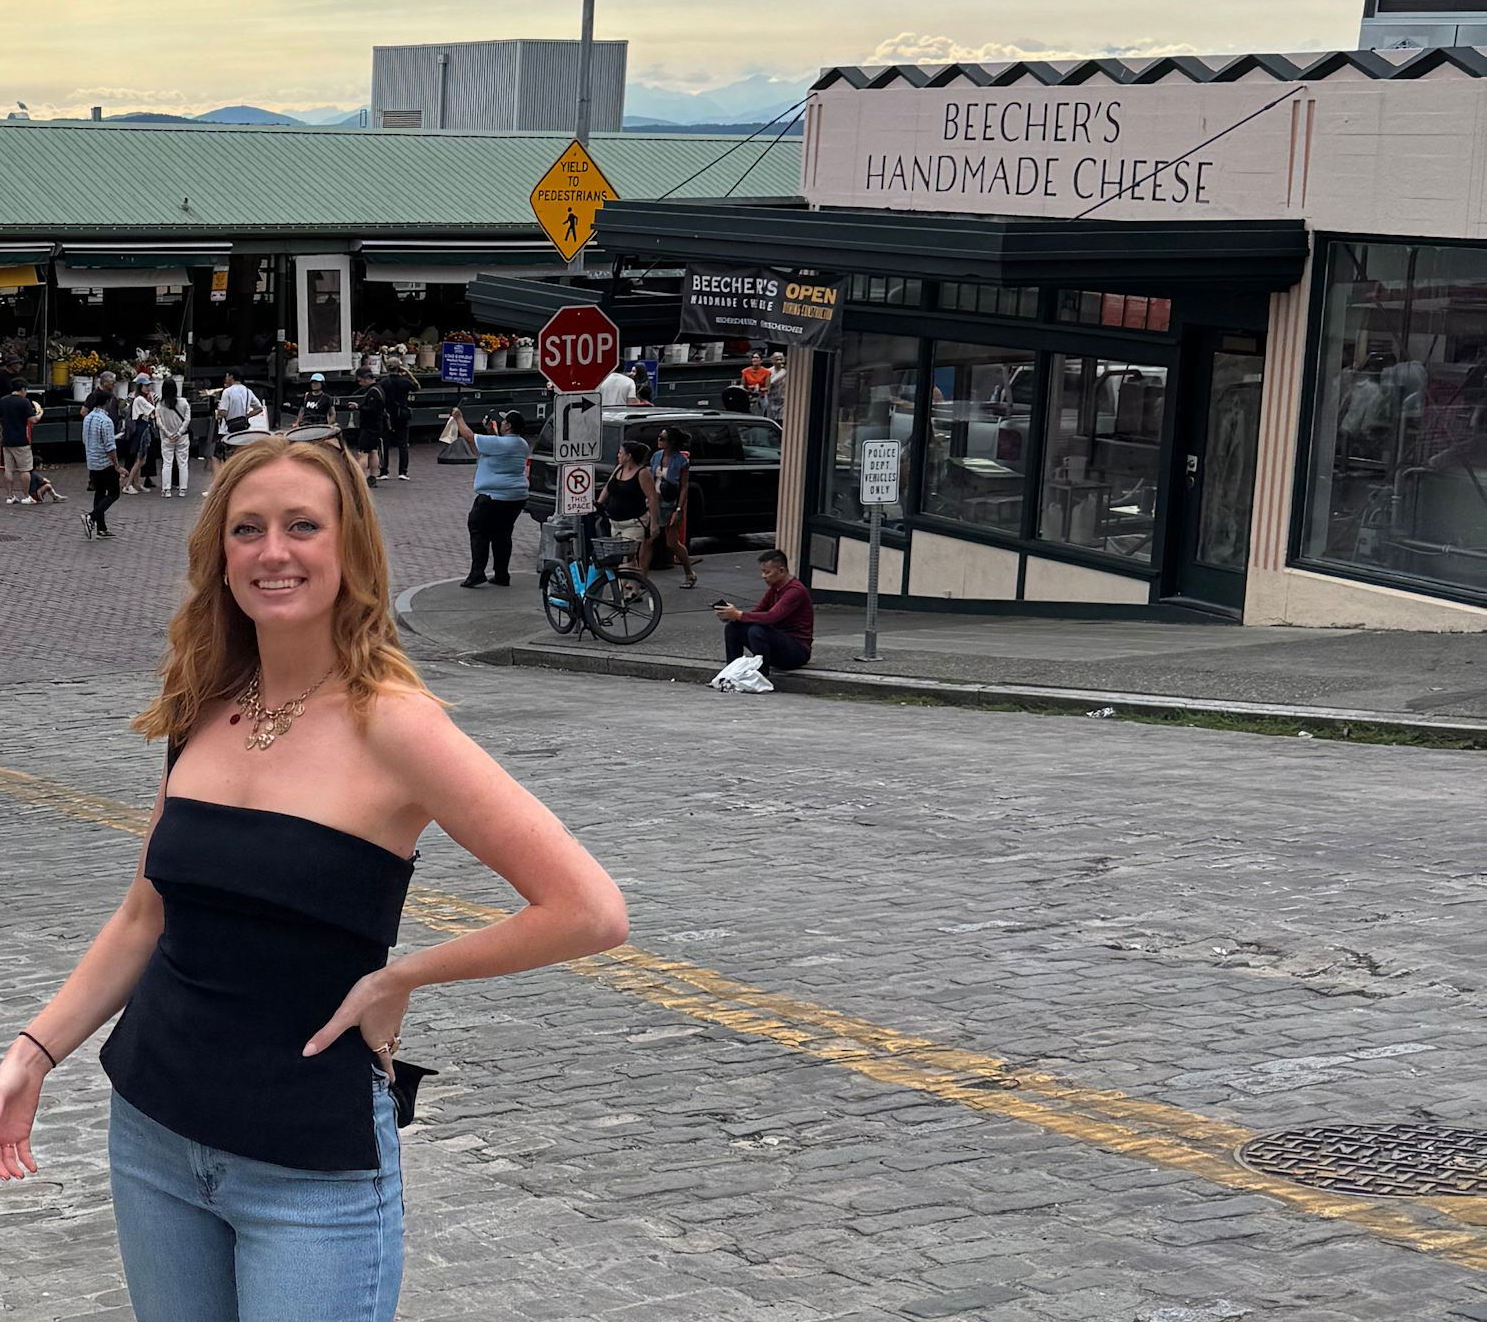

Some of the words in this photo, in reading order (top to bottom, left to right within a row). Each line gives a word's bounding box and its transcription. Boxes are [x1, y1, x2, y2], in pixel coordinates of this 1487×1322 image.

[943, 101, 1121, 144] BEECHER'S
[561, 161, 589, 173] YIELD
[568, 176, 579, 187] TO
[866, 154, 1059, 197] HANDMADE
[1073, 158, 1213, 204] CHEESE
[538, 190, 607, 202] PEDESTRIANS
[693, 275, 778, 296] BEECHER'S
[785, 283, 837, 305] OPEN
[545, 332, 613, 367] STOP
[559, 441, 597, 458] ONLY
[868, 449, 896, 458] POLICE
[865, 473, 897, 482] VEHICLES
[870, 486, 890, 494] ONLY
[570, 495, 587, 503] THIS
[567, 502, 591, 510] SPACE
